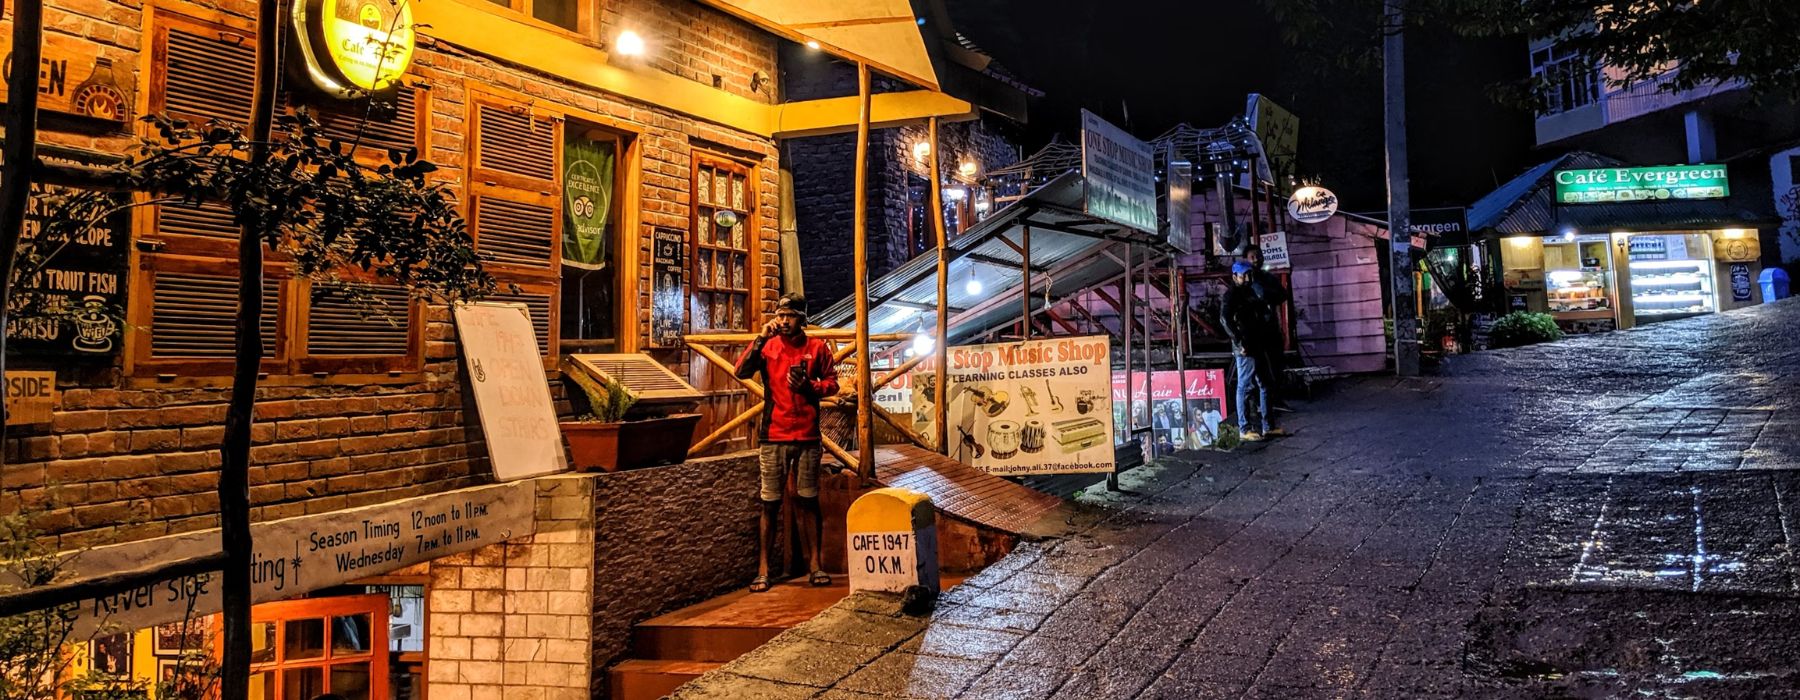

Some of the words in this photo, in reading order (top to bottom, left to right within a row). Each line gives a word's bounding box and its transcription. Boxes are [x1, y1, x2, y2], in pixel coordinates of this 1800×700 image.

[1556, 170, 1608, 185] Café
[1616, 168, 1728, 184] Evergreen
[1409, 221, 1461, 235] ergreen
[46, 269, 85, 291] TROUT
[89, 272, 118, 294] FISH
[953, 350, 994, 373] Stop
[998, 341, 1053, 366] Music
[1058, 340, 1106, 365] Shop
[952, 371, 1005, 383] LEARNING
[1008, 367, 1056, 379] CLASSES
[1059, 365, 1088, 376] ALSO
[1183, 378, 1218, 396] Arts
[309, 530, 358, 552] Season
[362, 519, 400, 539] Timing
[424, 513, 447, 526] noon
[451, 504, 461, 521] to
[336, 543, 405, 573] Wednesday
[443, 529, 452, 546] to
[853, 534, 880, 551] CAFE
[882, 533, 909, 550] 1947
[250, 552, 285, 591] ting
[878, 555, 905, 575] K.M.
